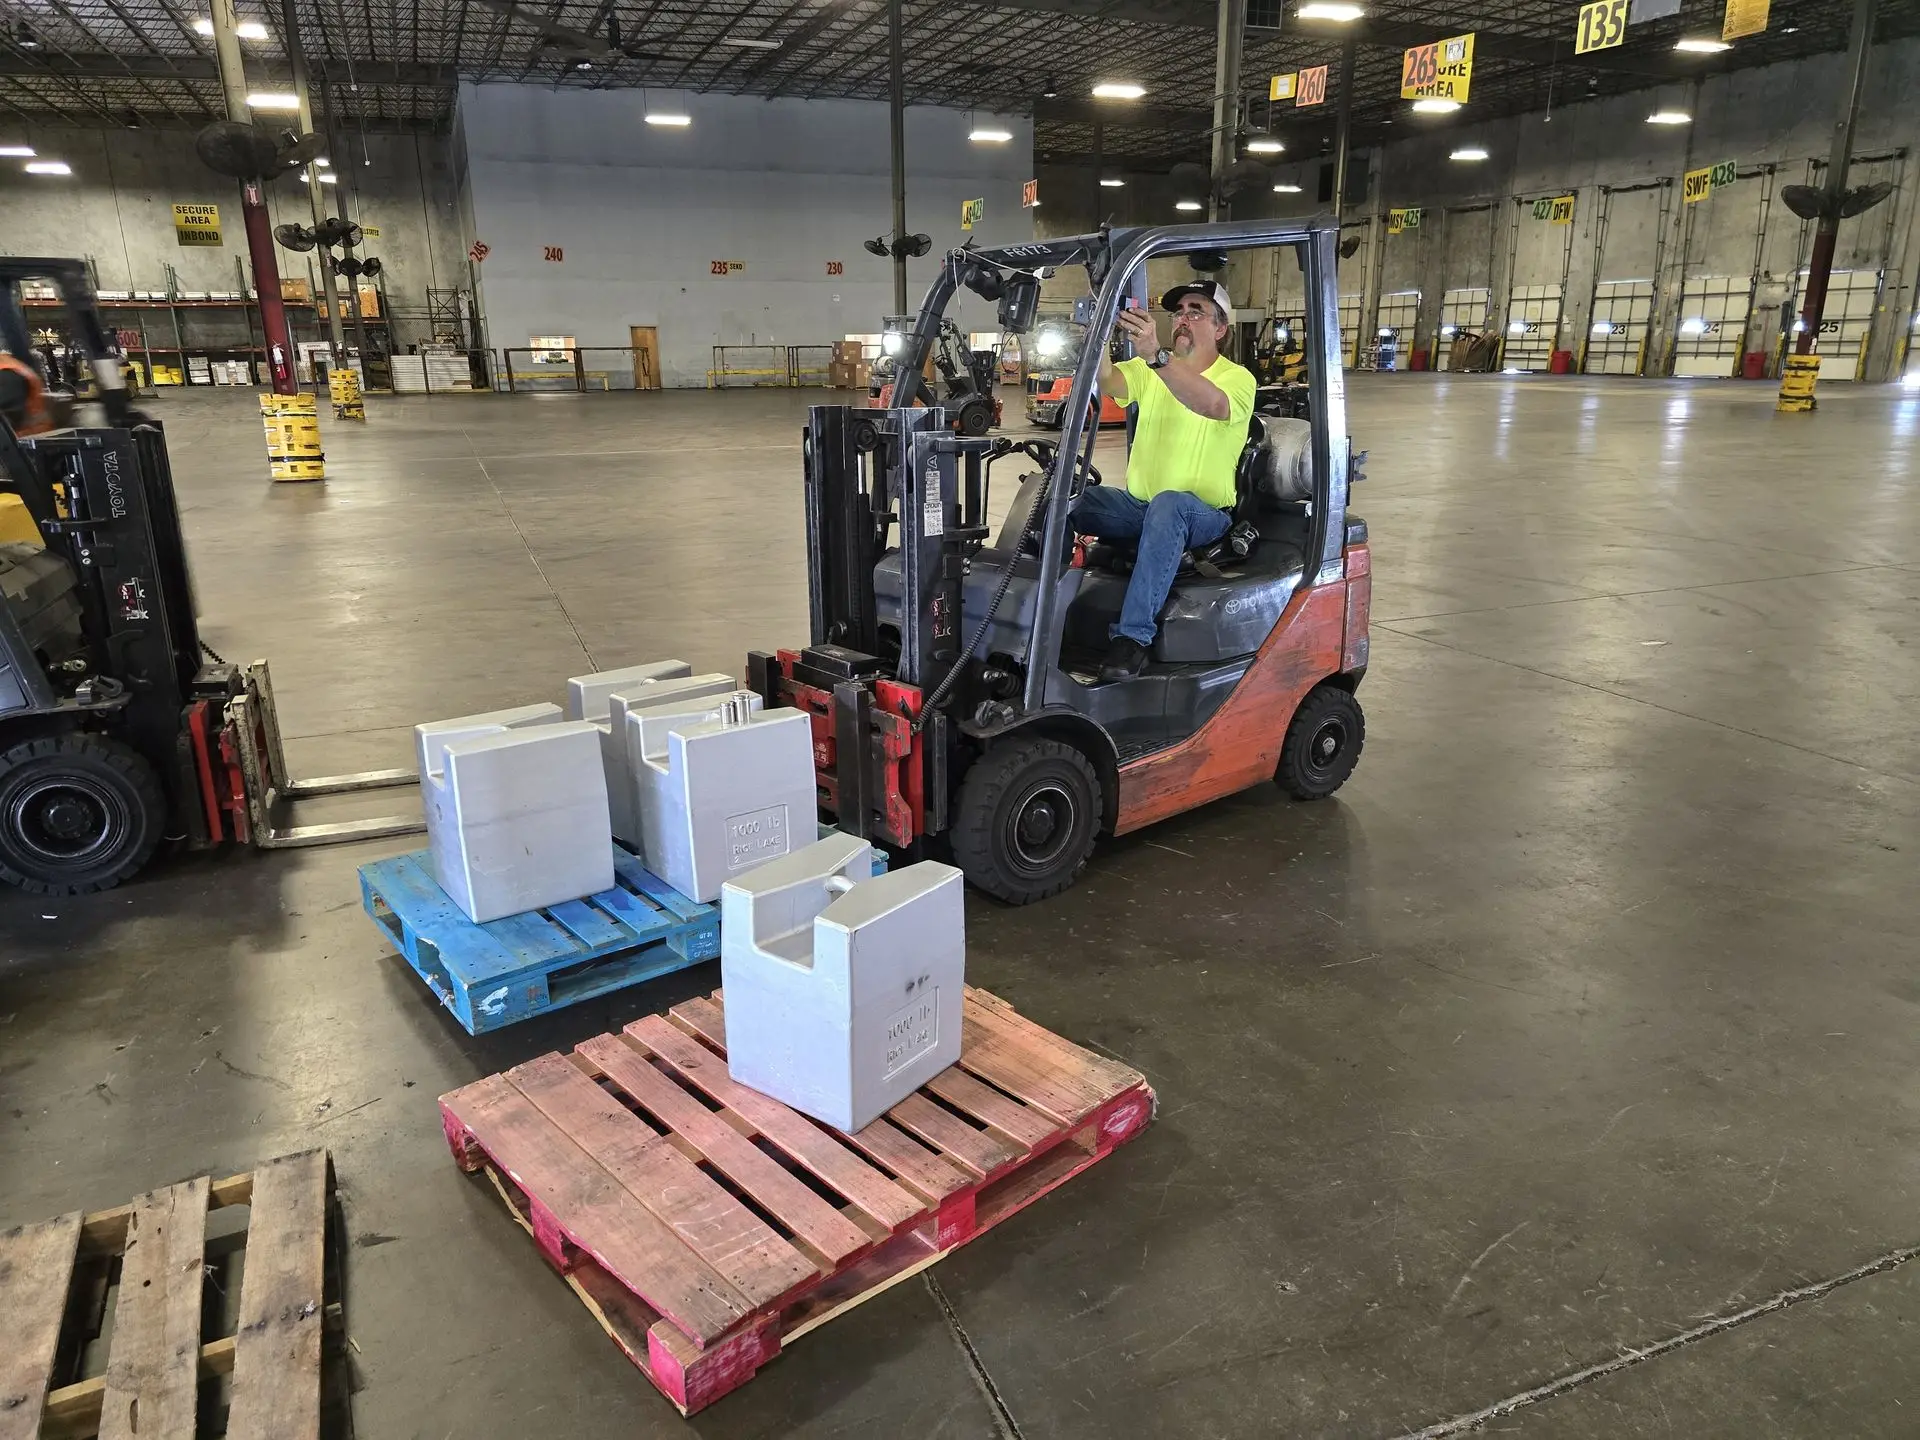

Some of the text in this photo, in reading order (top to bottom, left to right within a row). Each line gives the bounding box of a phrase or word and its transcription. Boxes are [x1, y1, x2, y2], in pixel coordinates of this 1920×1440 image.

[1581, 0, 1625, 51] 135
[1404, 45, 1439, 87] 265
[1297, 68, 1325, 104] 260
[1710, 161, 1736, 188] 428
[1686, 173, 1709, 197] SWF
[175, 205, 216, 215] SECURE
[1403, 209, 1420, 227] 425
[1532, 200, 1553, 220] 427
[1552, 201, 1572, 221] DFW
[184, 215, 211, 225] AREA
[1389, 213, 1405, 229] MSY
[179, 230, 220, 241] INBOND
[469, 241, 489, 263] 245
[544, 246, 563, 262] 240
[1002, 244, 1053, 258] F6173
[711, 261, 728, 275] 235
[826, 261, 843, 275] 230
[1526, 324, 1538, 333] 22
[1611, 324, 1625, 335] 23
[1820, 321, 1839, 333] 25
[103, 450, 126, 519] TOYOTA
[732, 820, 760, 838] 1000
